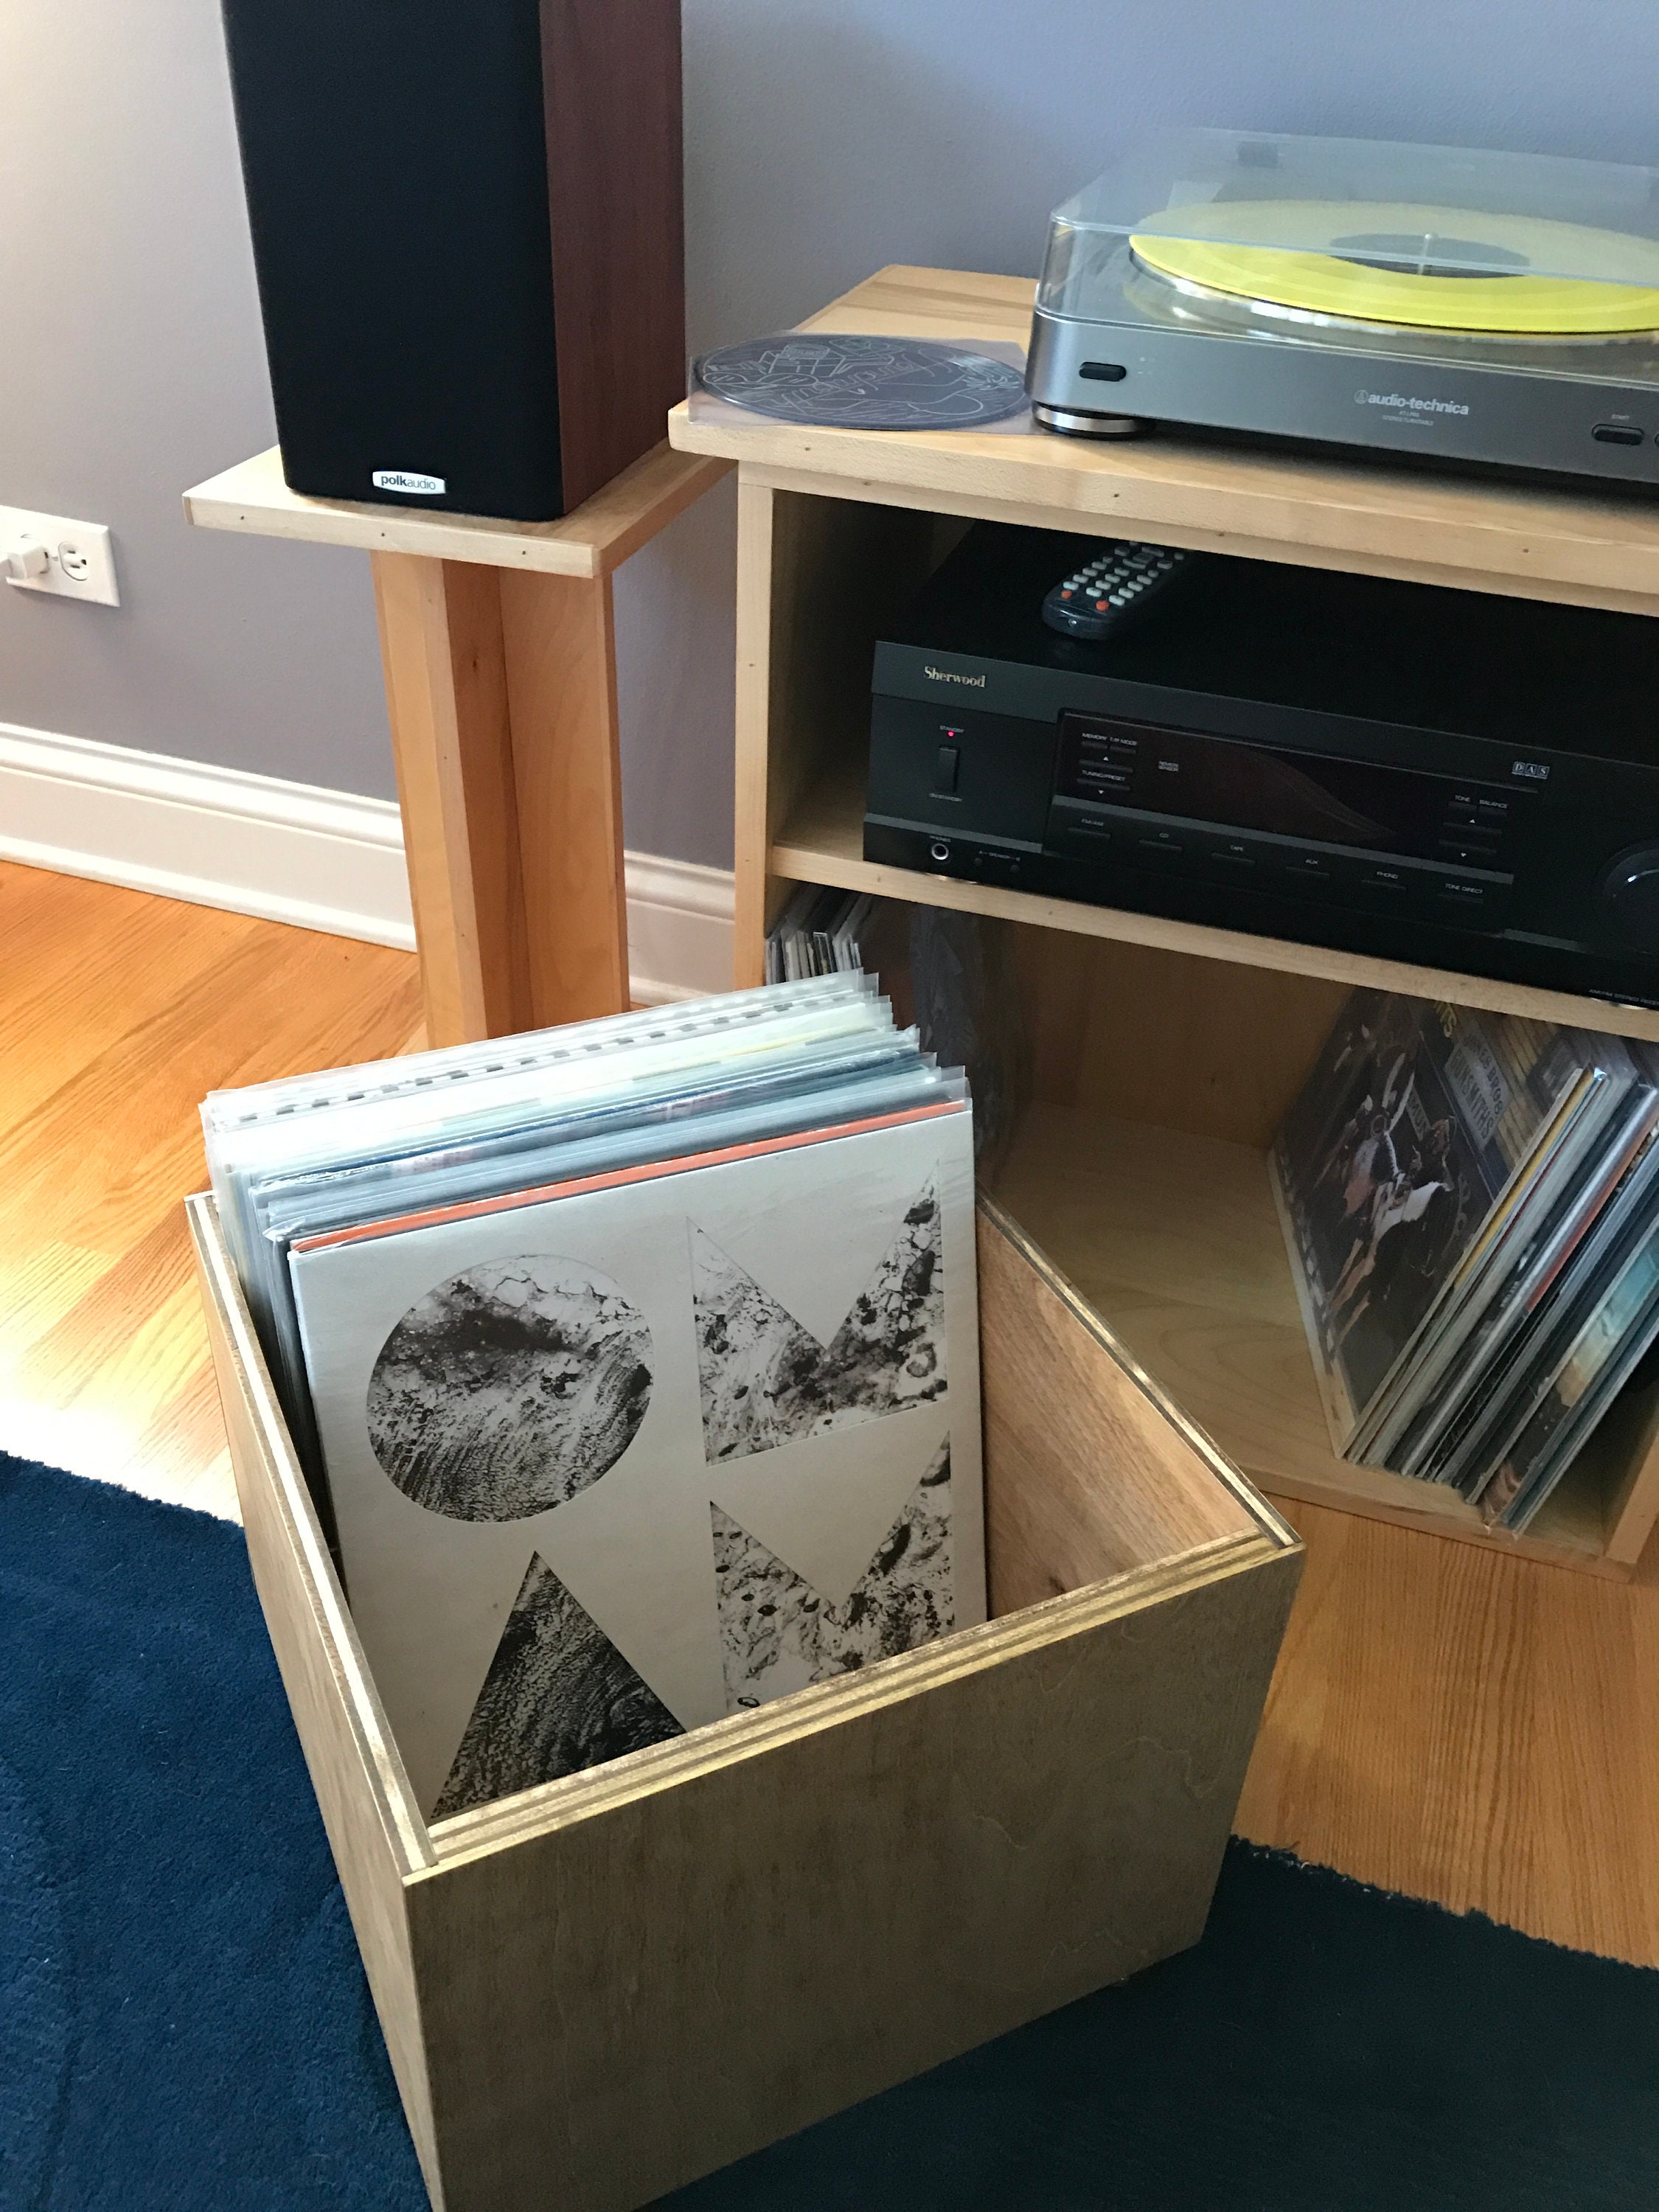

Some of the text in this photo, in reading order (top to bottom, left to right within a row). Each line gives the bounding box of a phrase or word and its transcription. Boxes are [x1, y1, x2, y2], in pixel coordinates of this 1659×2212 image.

[1368, 393, 1470, 415] audio-technica
[380, 475, 436, 490] polkaudio
[924, 666, 986, 688] Sherwood
[1514, 762, 1548, 776] DAS
[1479, 799, 1509, 809] BALANCE
[1376, 871, 1399, 880] PHONO
[1450, 1048, 1494, 1138] GUNSMITHS
